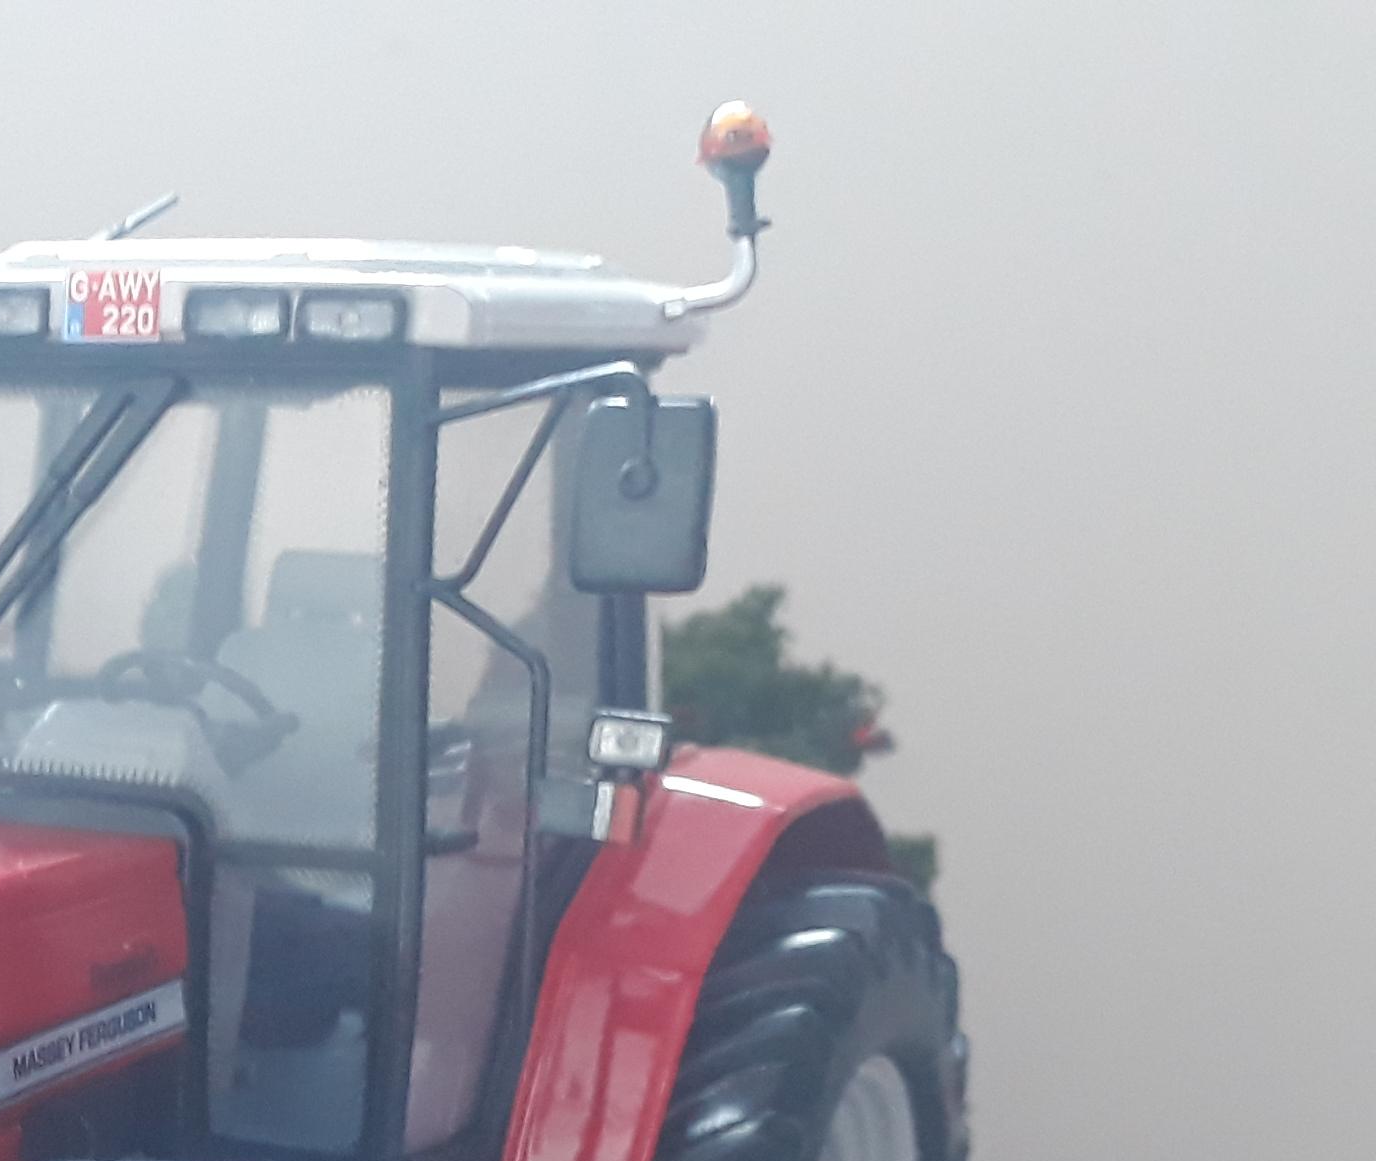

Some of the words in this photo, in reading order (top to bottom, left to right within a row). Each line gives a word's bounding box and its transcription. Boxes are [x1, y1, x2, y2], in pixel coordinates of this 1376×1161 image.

[102, 303, 154, 336] 220
[13, 1032, 74, 1081] MASSEY
[80, 1001, 156, 1051] FERGUSON
